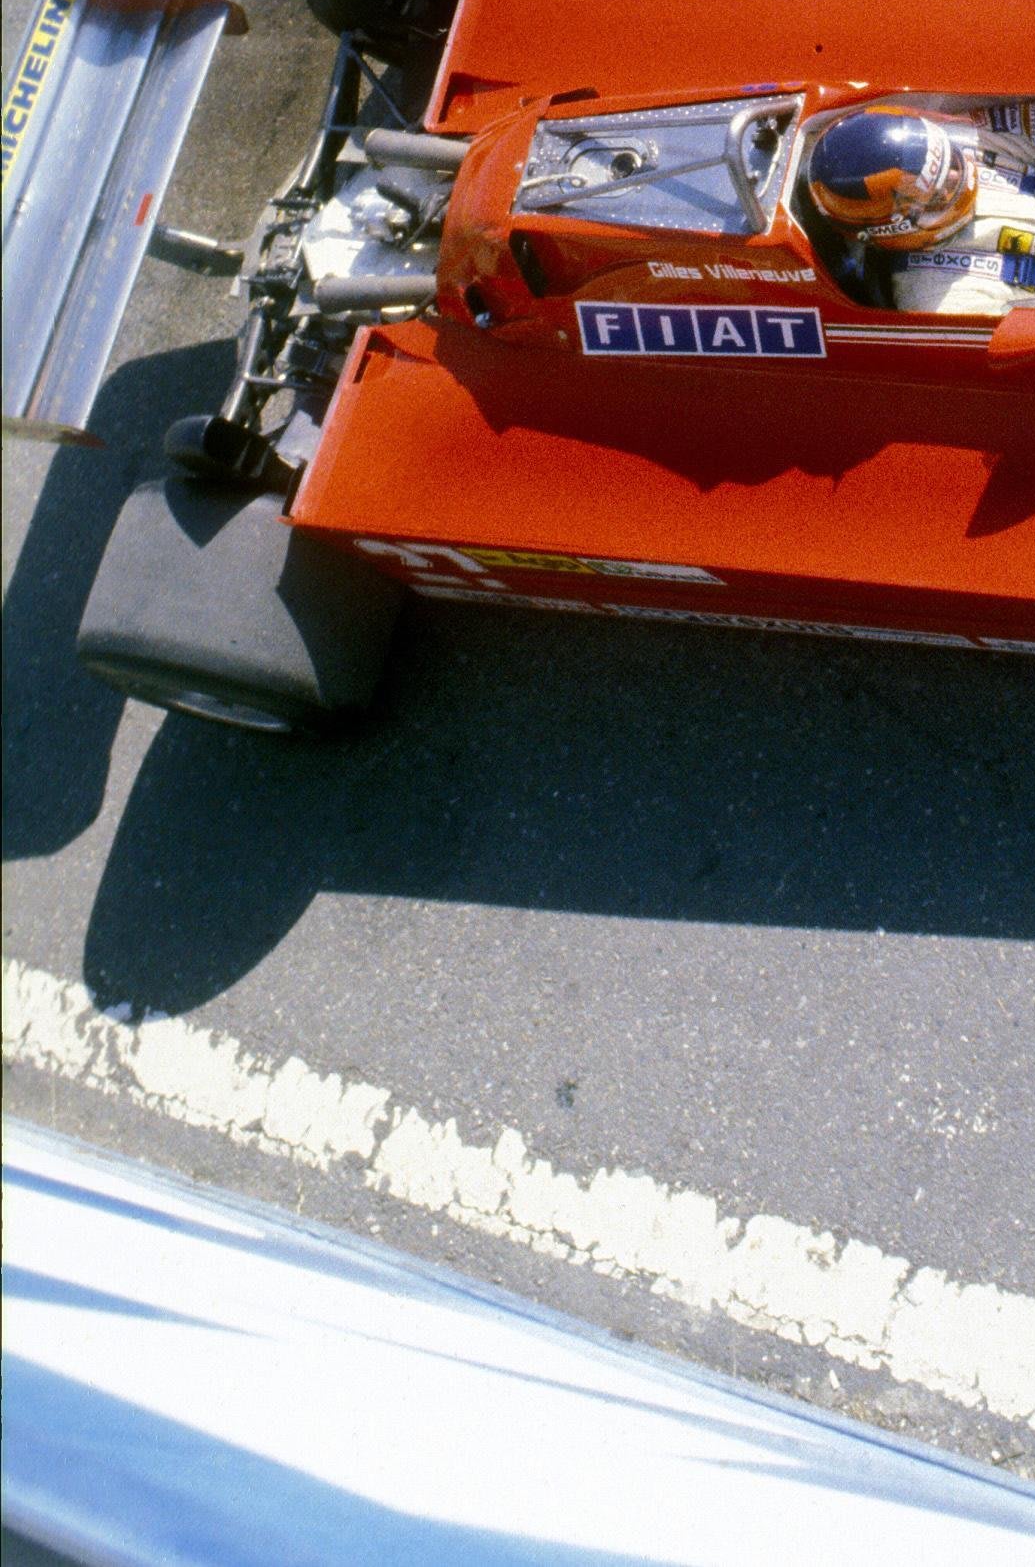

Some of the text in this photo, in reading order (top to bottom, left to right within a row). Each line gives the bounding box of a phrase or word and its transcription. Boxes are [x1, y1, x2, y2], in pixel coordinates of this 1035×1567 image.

[648, 261, 817, 283] Gilles Villeneuve
[594, 313, 804, 349] FIAT
